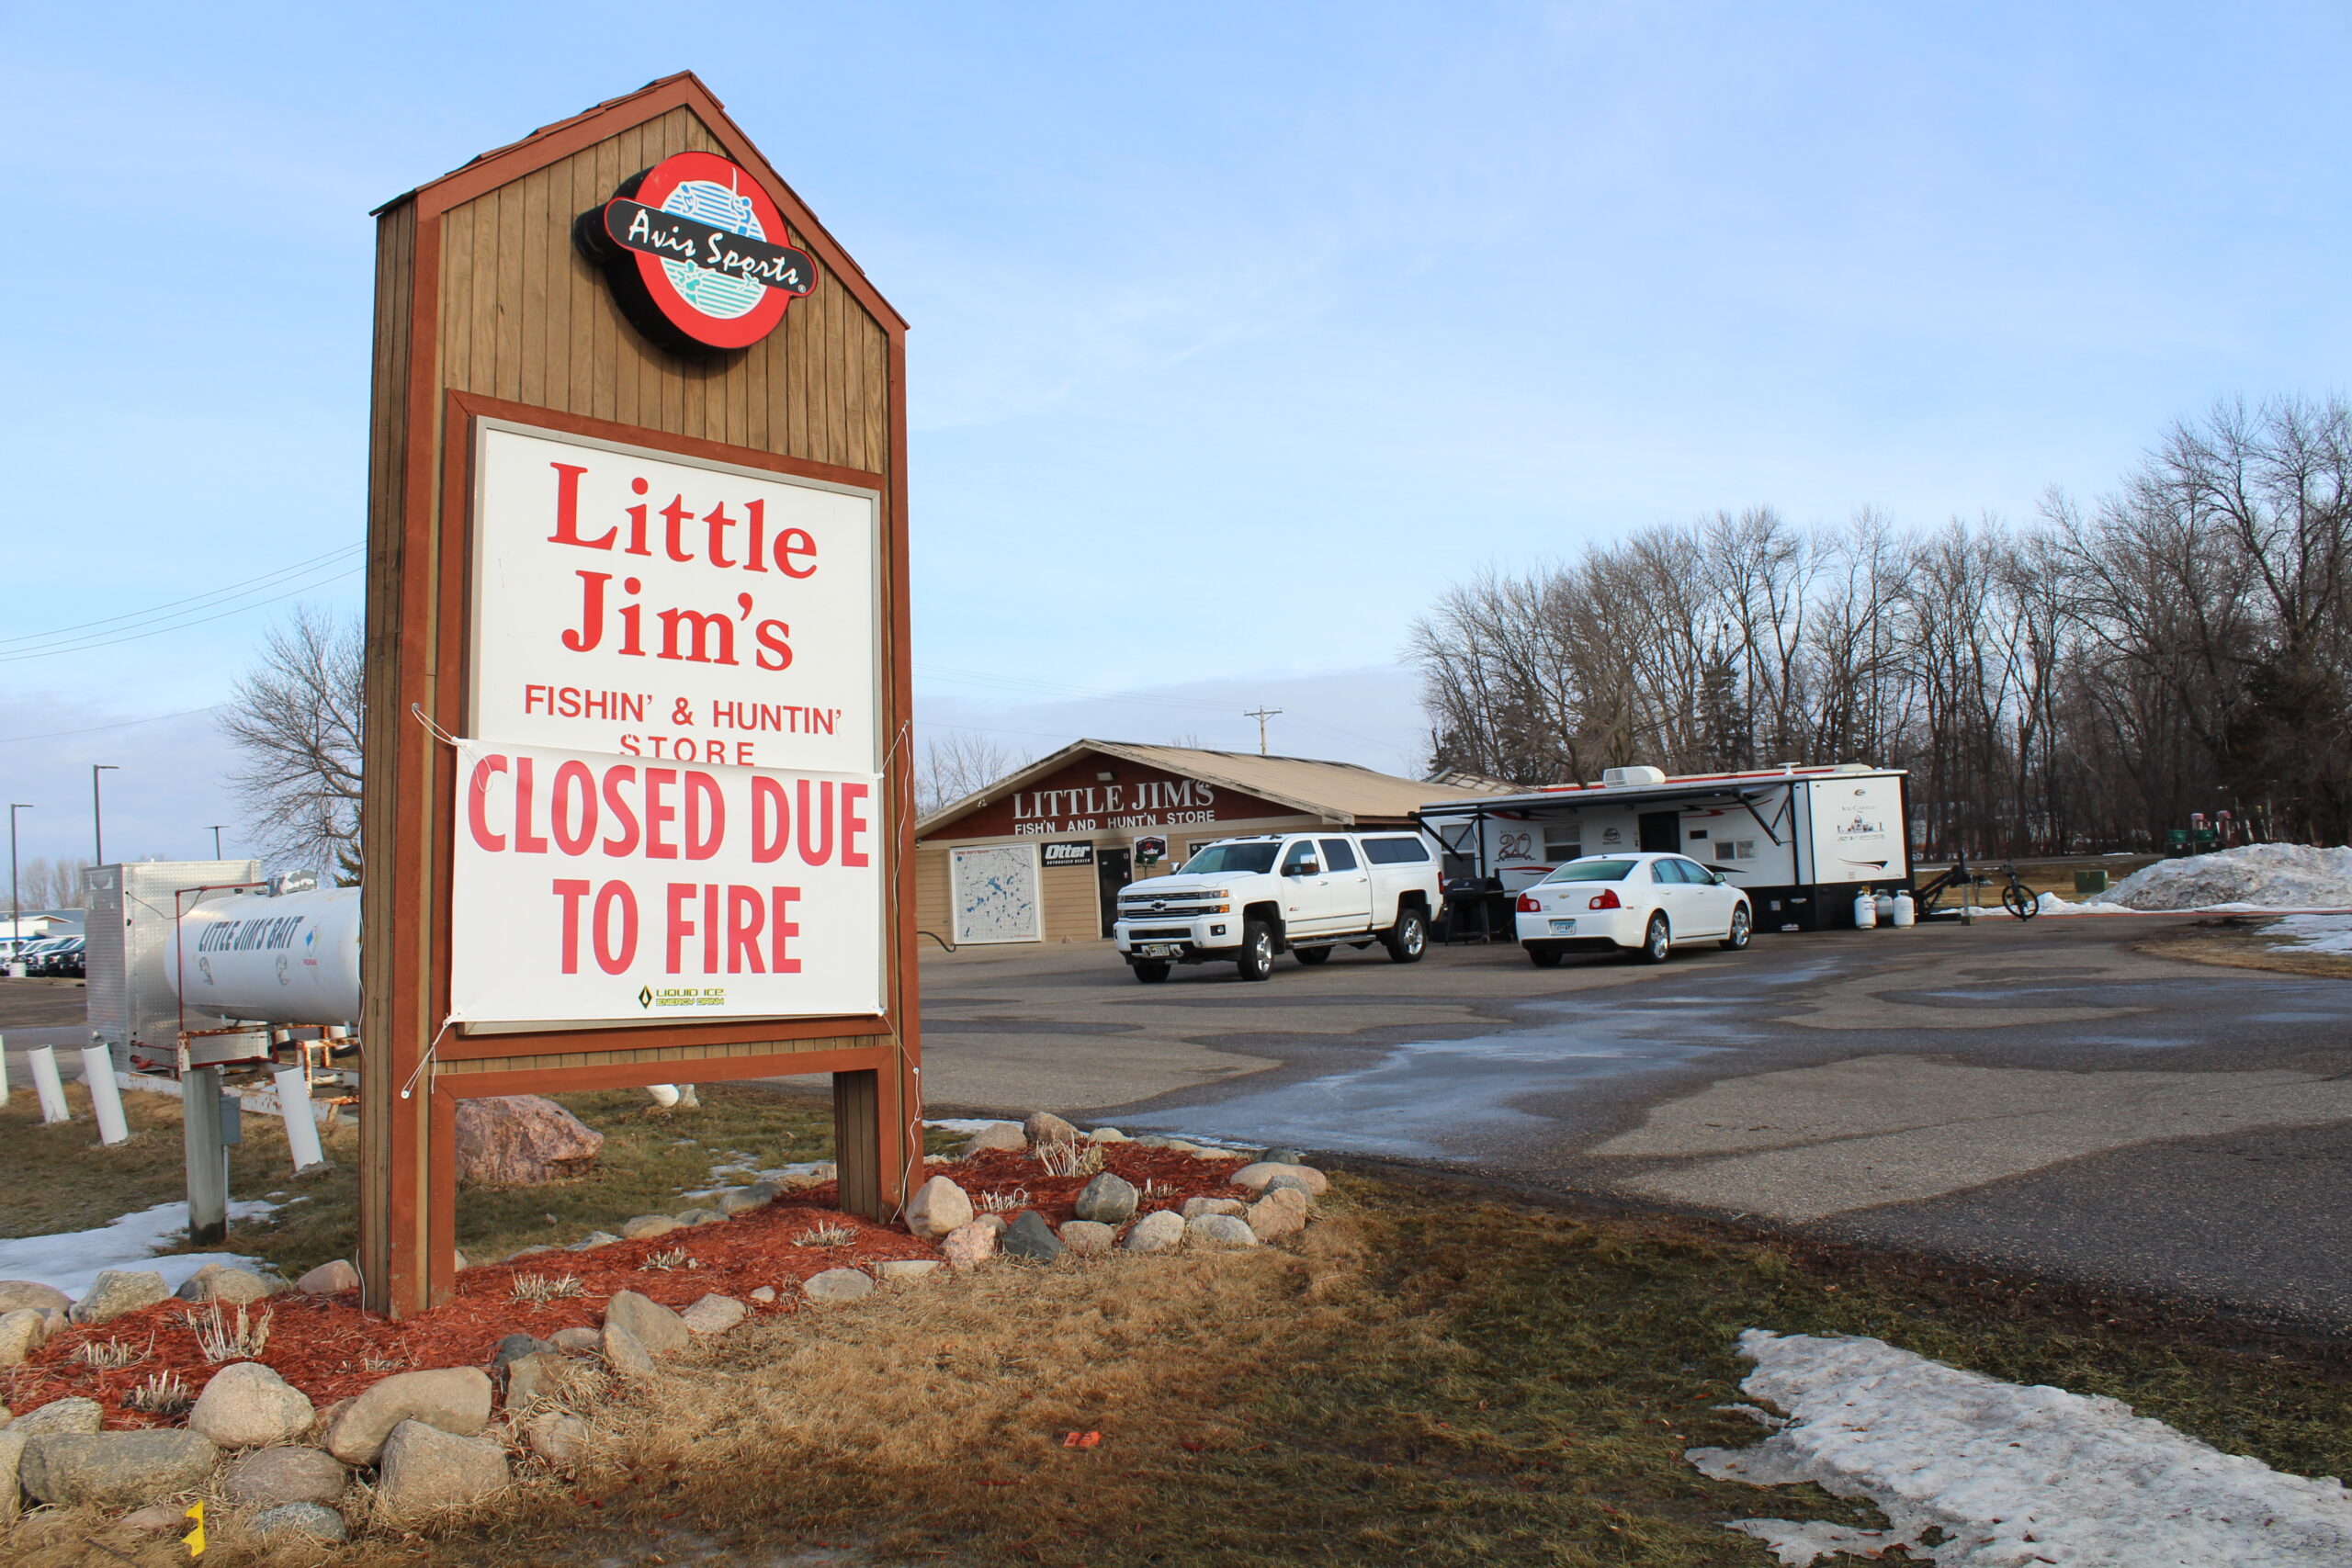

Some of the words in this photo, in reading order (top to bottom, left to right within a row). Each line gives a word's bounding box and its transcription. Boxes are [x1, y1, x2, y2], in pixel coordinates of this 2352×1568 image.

[628, 209, 695, 257] Avis
[707, 232, 798, 284] Sports
[547, 461, 817, 579] Little
[561, 570, 793, 671] Jim's
[525, 684, 653, 722] FISHIN'
[671, 697, 695, 727] &
[713, 700, 842, 736] HUNTIN'
[619, 734, 754, 767] STORE
[468, 754, 726, 861] CLOSED
[752, 775, 869, 868] DUE
[1012, 785, 1125, 819] LITTLE
[1131, 779, 1215, 810] JIM'S
[1014, 819, 1056, 836] FISH'N
[1067, 818, 1096, 832] AND
[1107, 812, 1157, 829] HUNT'N
[1167, 810, 1215, 825] STORE
[1045, 844, 1091, 860] Otter
[198, 920, 241, 952] LITTLE
[233, 918, 276, 950] JIM'S
[266, 915, 305, 949] BAIT
[552, 878, 639, 976] TO
[666, 883, 802, 975] FIRE
[656, 988, 698, 997] LIQUID
